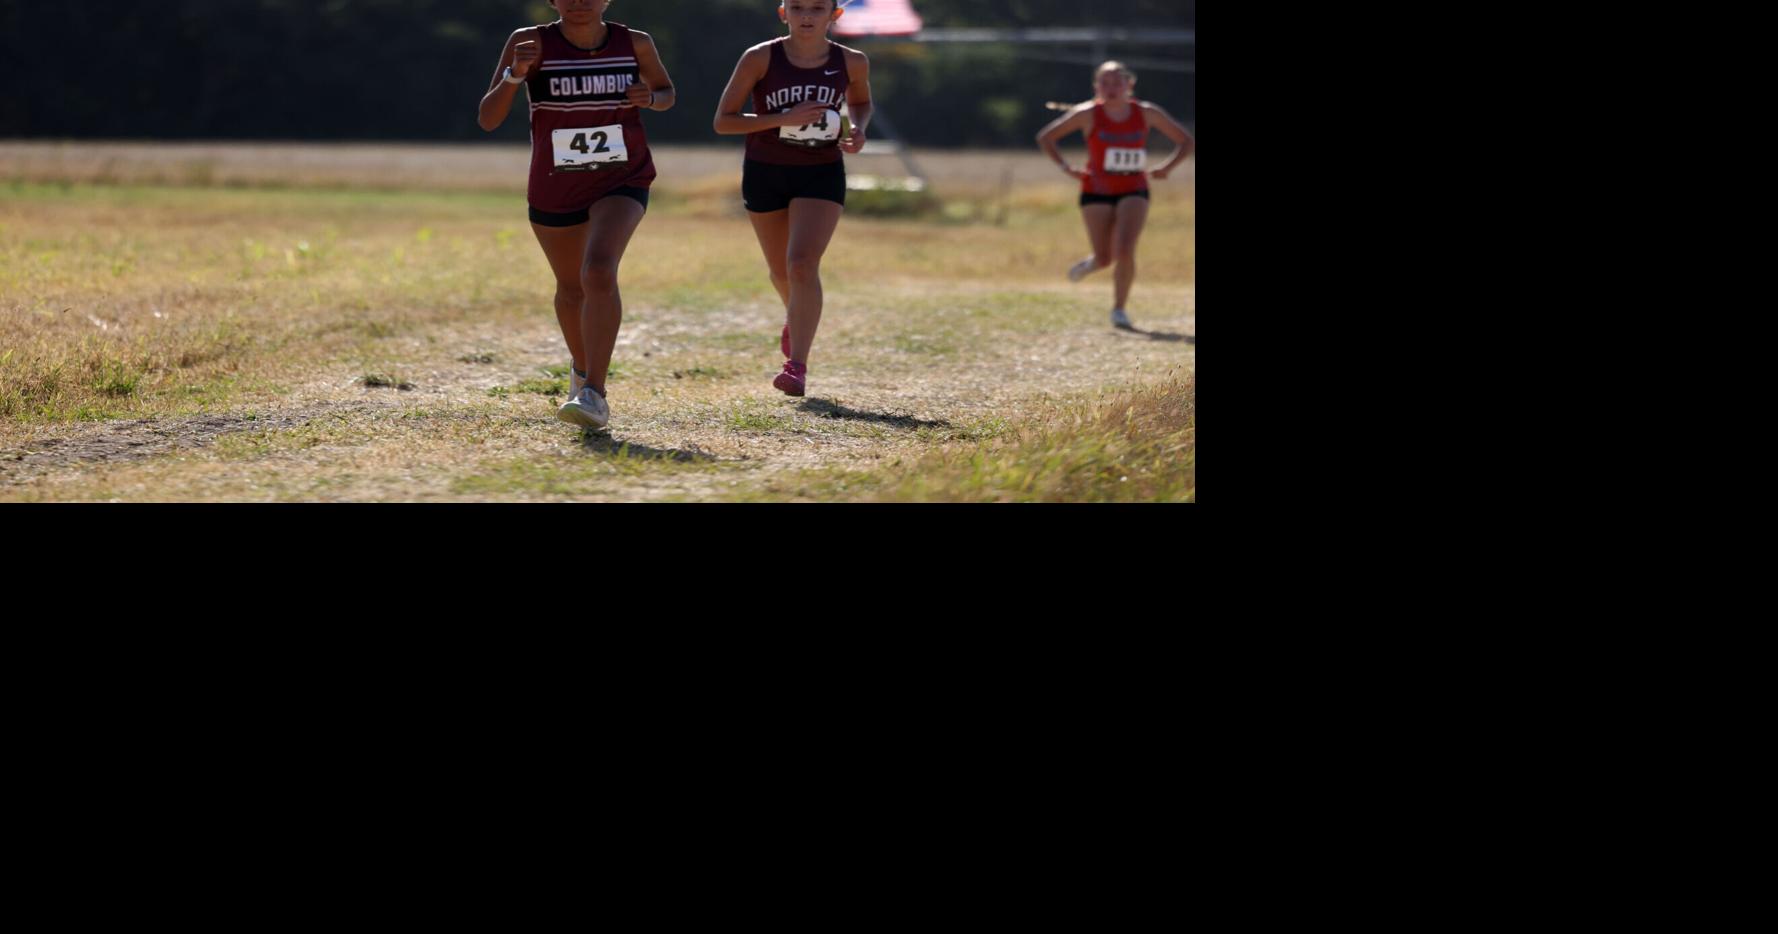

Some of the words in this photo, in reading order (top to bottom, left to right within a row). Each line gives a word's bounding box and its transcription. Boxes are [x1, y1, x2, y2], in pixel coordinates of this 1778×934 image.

[549, 74, 634, 96] COLUMBUS
[799, 112, 829, 132] 4
[569, 131, 610, 155] 42
